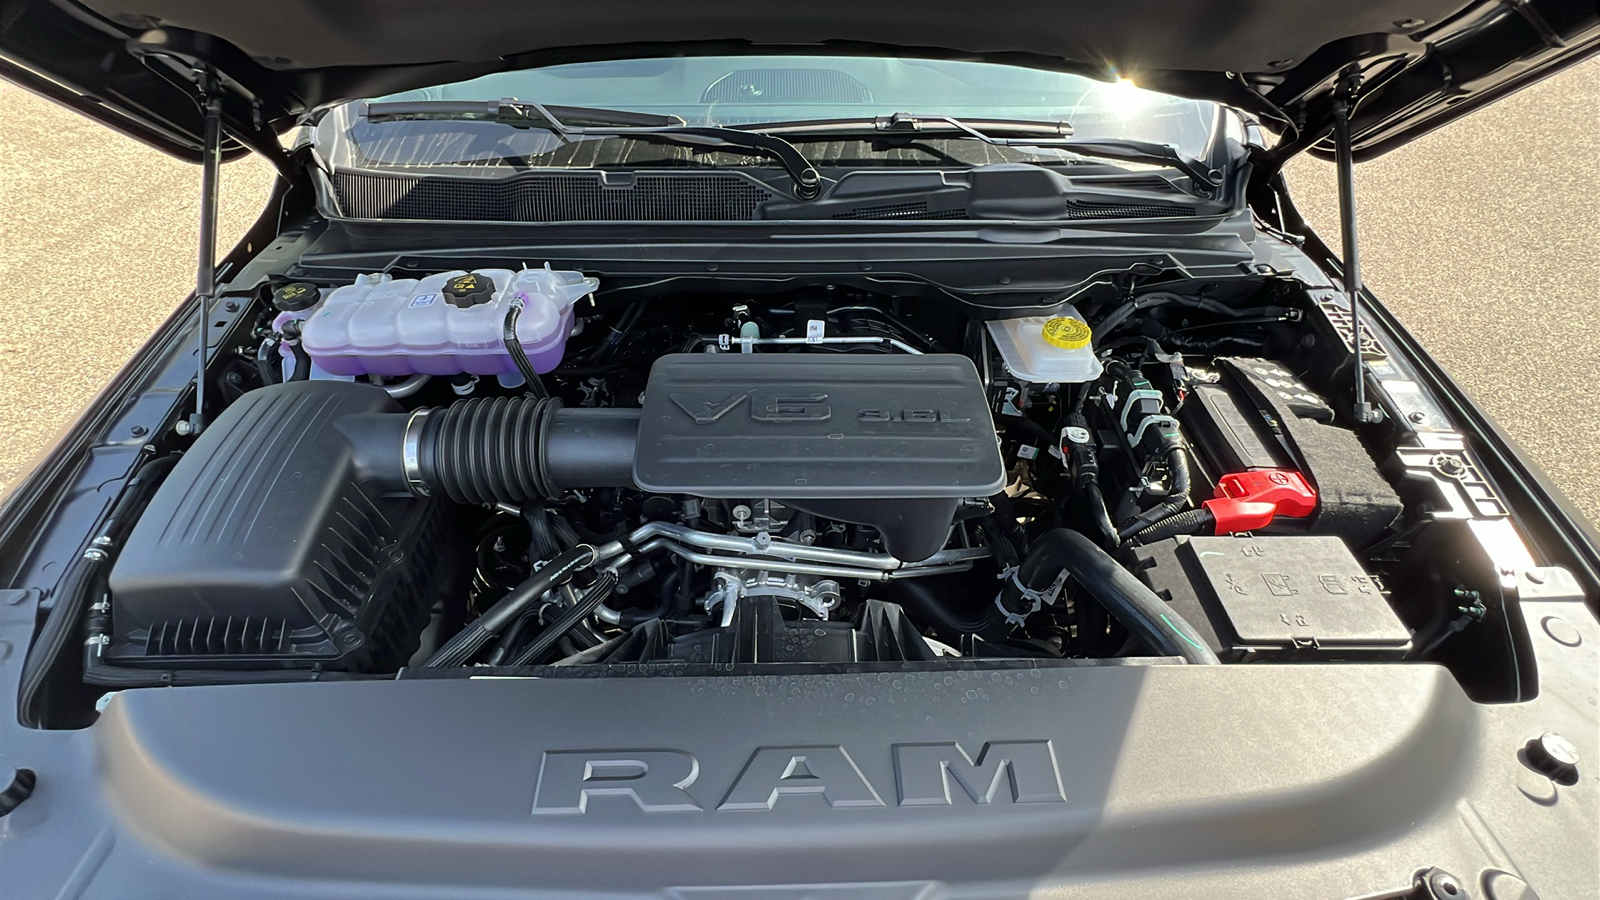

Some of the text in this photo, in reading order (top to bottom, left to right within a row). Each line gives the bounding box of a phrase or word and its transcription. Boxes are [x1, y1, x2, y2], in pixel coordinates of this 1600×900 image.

[668, 393, 970, 423] V6 3.6L
[531, 739, 1068, 815] RAM
